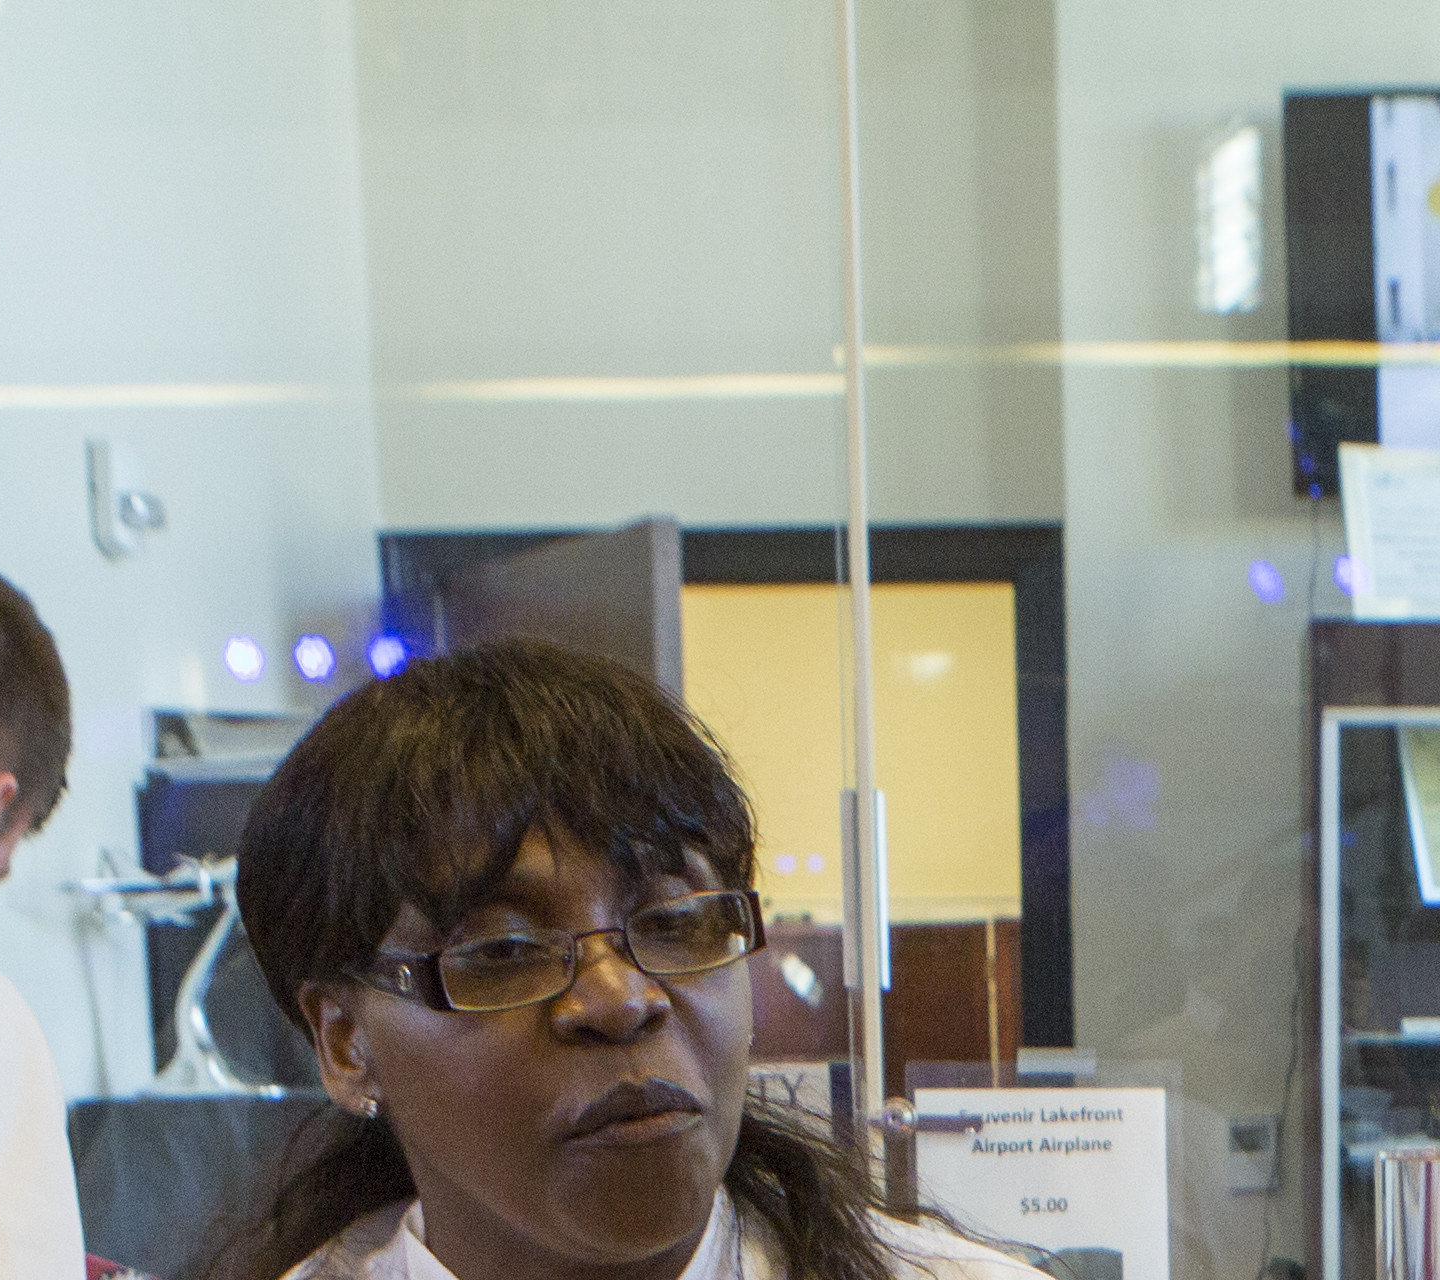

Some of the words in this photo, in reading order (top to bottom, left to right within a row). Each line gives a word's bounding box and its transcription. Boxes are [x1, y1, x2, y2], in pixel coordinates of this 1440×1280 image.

[960, 1107, 1035, 1124] uvenir
[1040, 1105, 1124, 1123] Lakefront
[972, 1137, 1034, 1156] Airport
[1039, 1136, 1113, 1155] Airplane
[1020, 1197, 1069, 1215] $5.00
